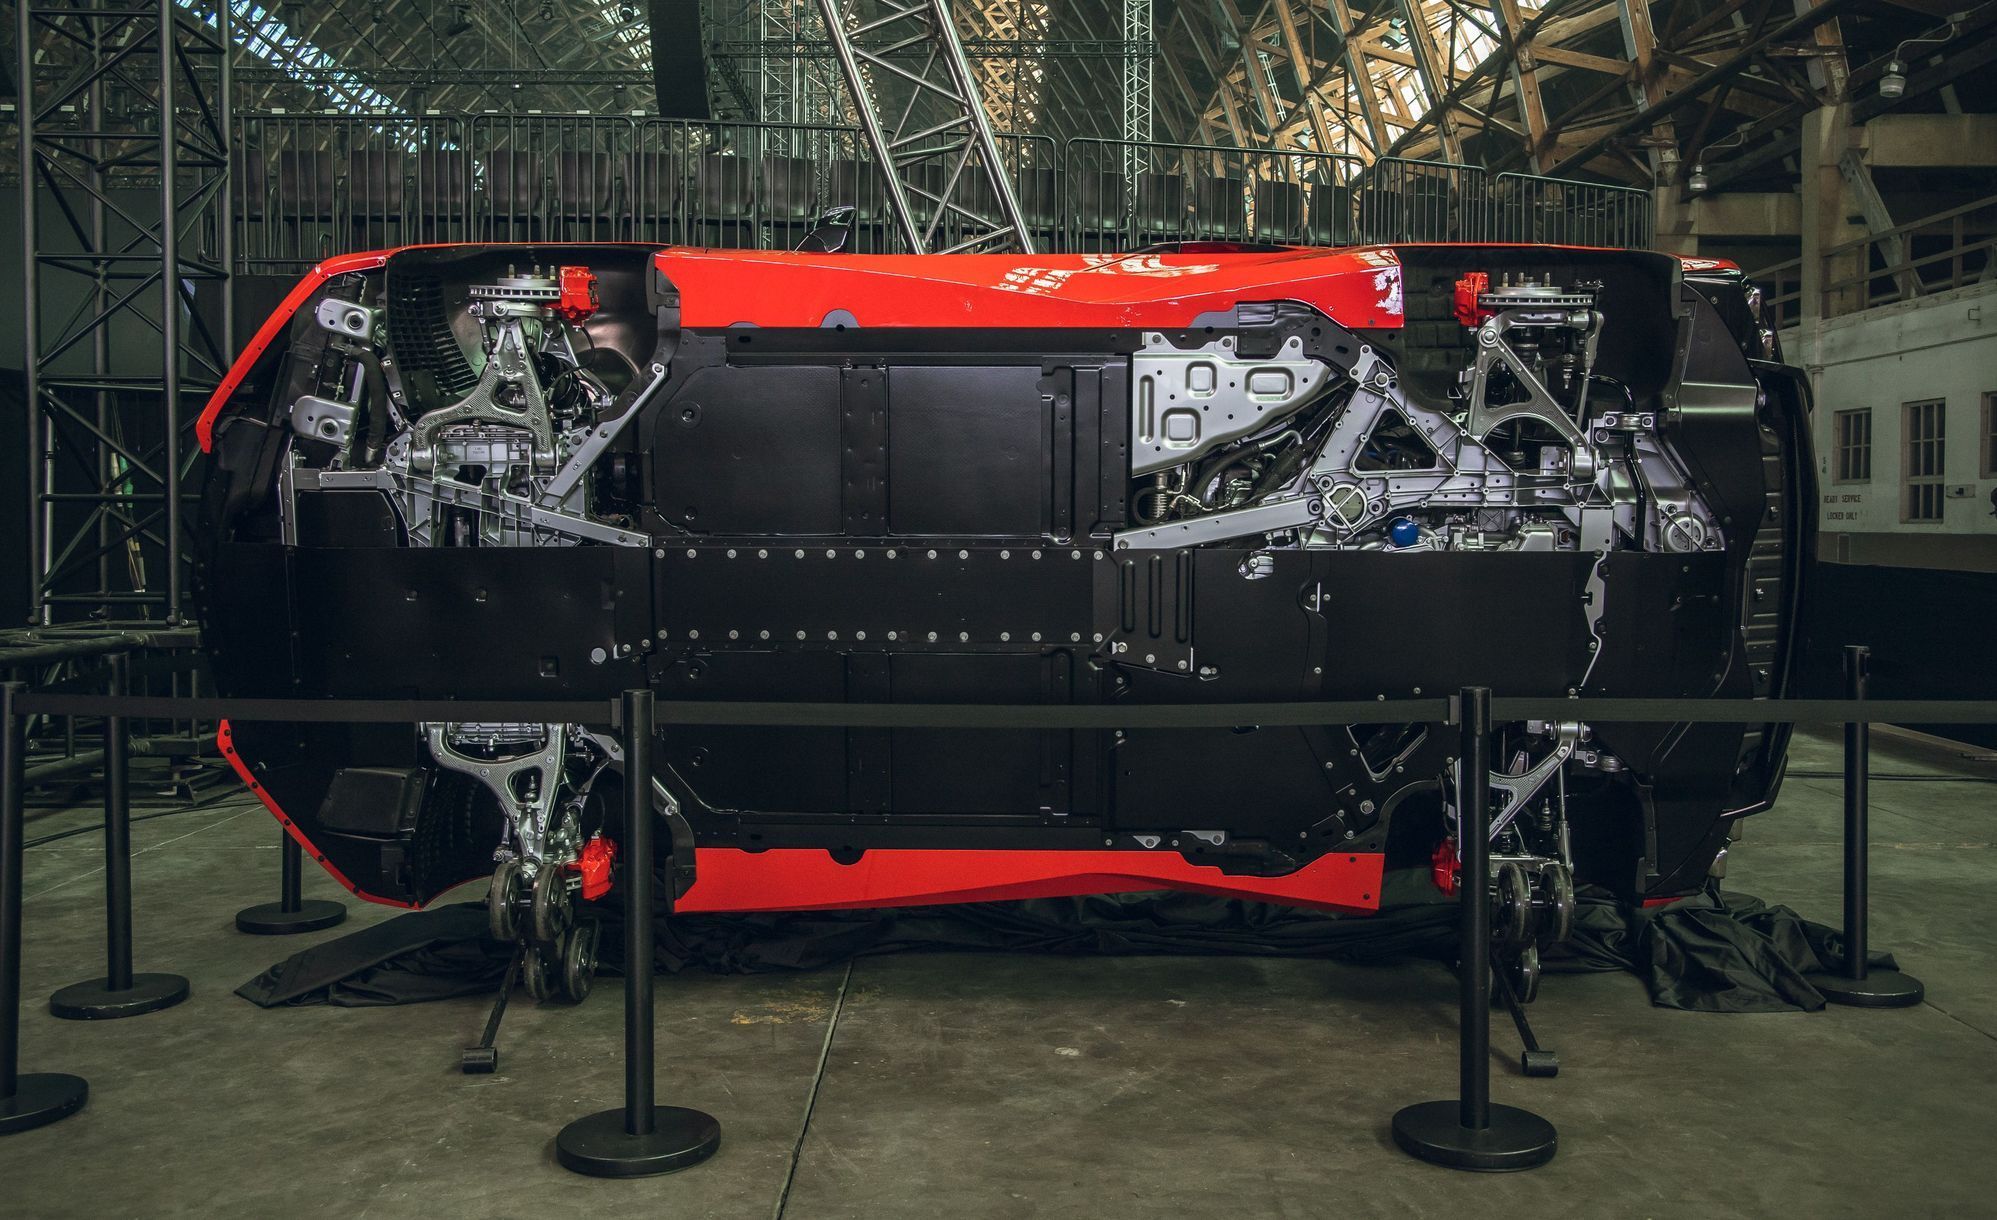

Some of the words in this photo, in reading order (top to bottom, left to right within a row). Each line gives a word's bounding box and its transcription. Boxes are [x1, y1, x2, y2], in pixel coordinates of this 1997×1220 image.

[1841, 494, 1862, 503] SERVICE
[1826, 511, 1844, 520] LOCKER
[1845, 511, 1858, 520] ONLY
